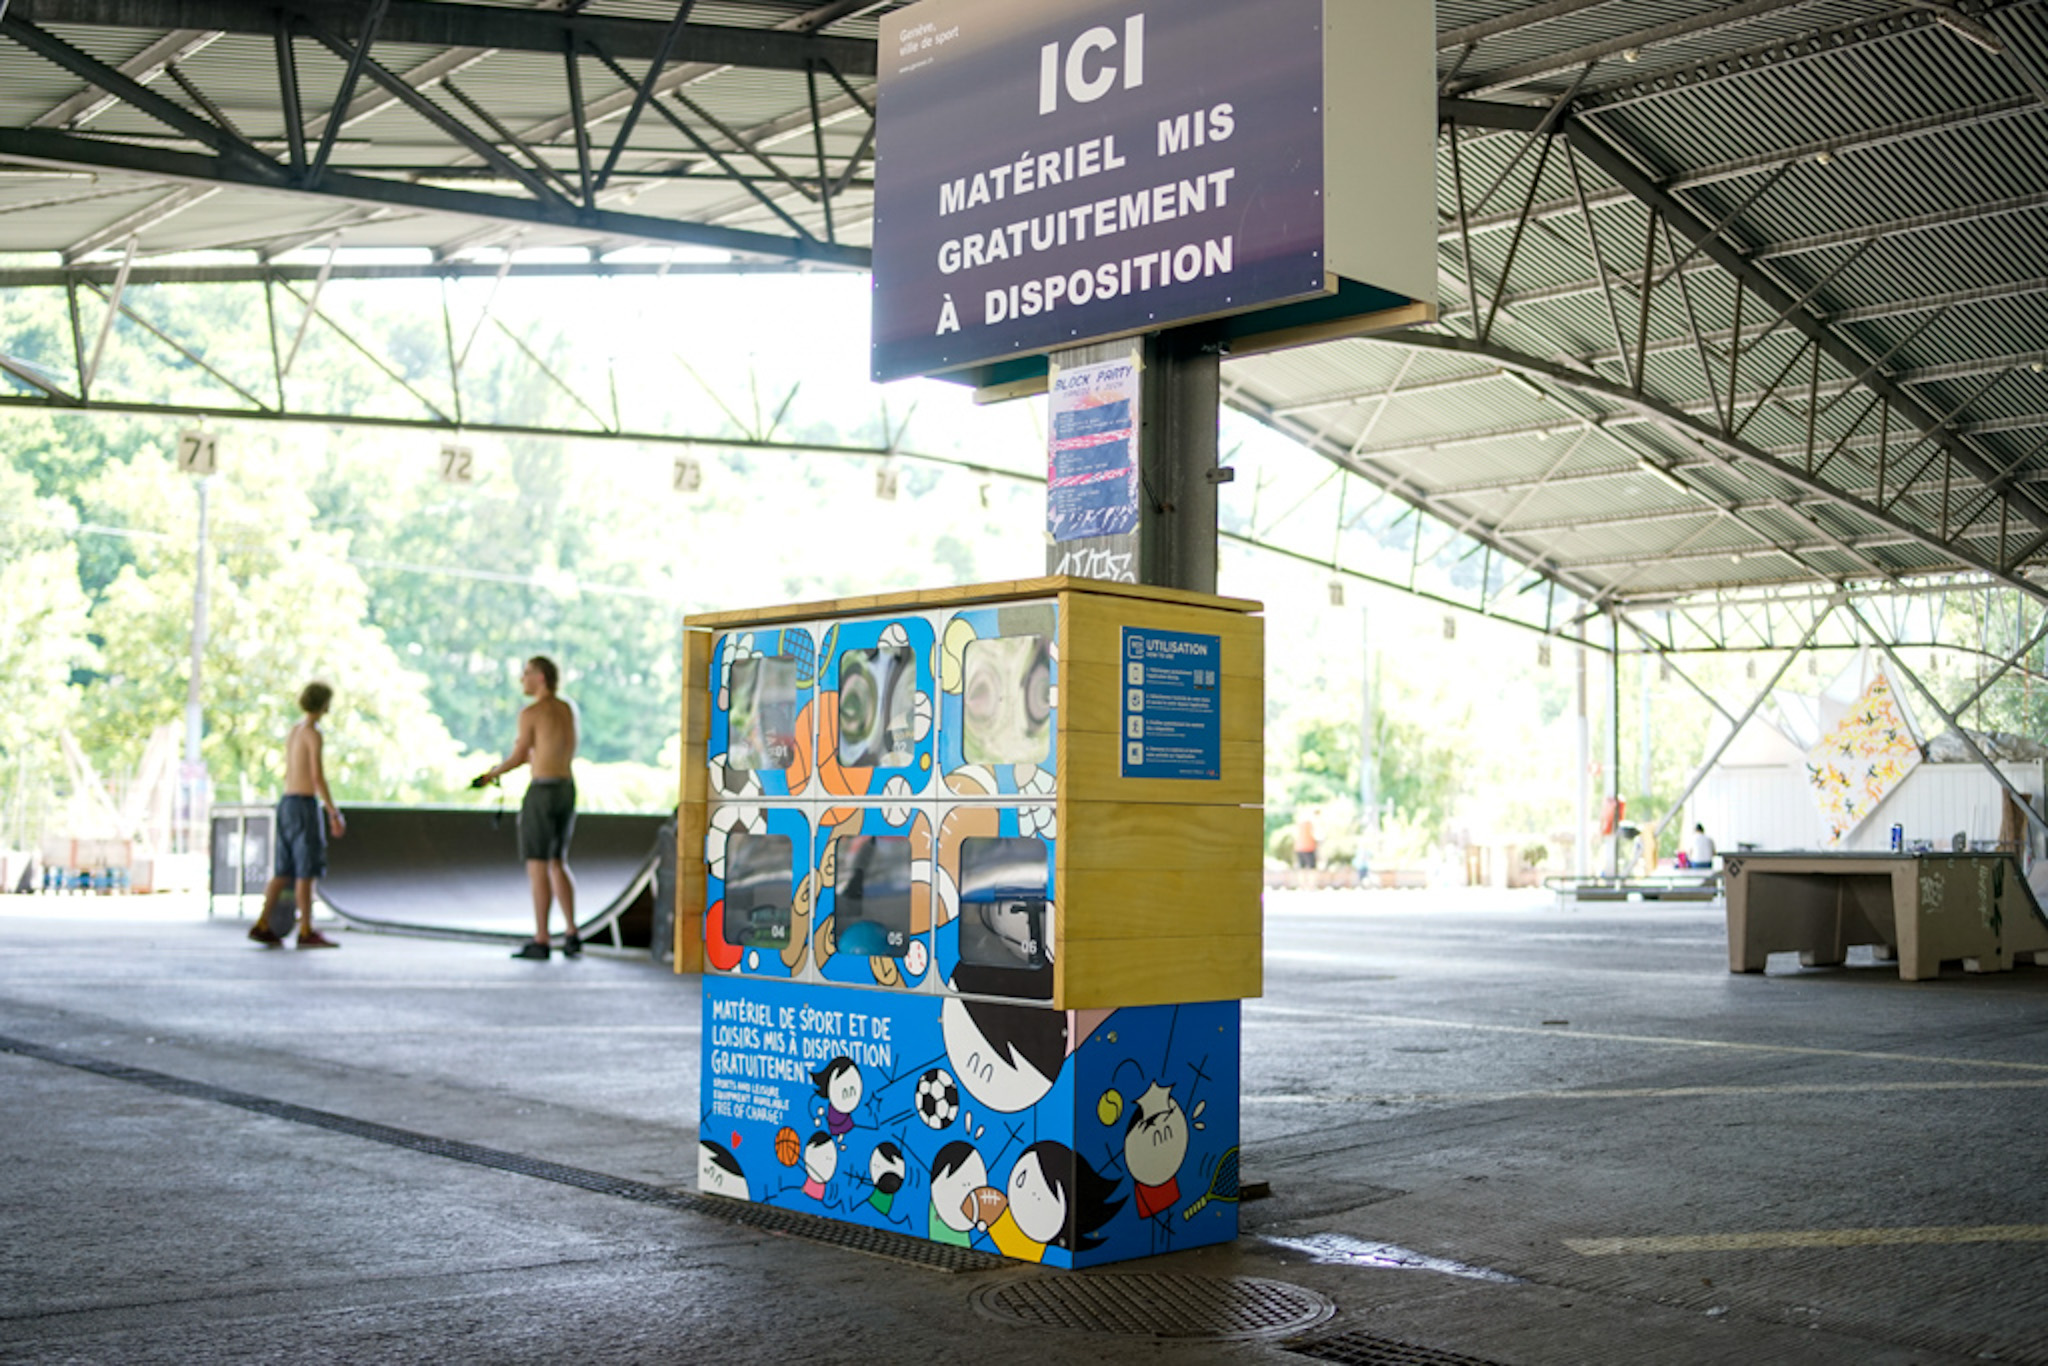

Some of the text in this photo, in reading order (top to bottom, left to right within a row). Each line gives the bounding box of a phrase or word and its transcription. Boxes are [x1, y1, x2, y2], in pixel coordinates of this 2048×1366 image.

[899, 25, 959, 56] ville de sport
[1039, 13, 1145, 115] ICI
[939, 103, 1235, 216] MATÉRIEL MIS
[938, 168, 1236, 275] GRATUITEMENT
[936, 235, 1233, 336] À DISPOSITION
[1054, 373, 1091, 391] BLOCK
[1096, 365, 1133, 383] PARTY
[184, 436, 216, 467] 71
[441, 450, 472, 480] 72
[1145, 639, 1208, 656] UTILISATION
[771, 925, 785, 938] 04
[887, 932, 903, 946] 05
[1020, 940, 1037, 954] 06
[712, 997, 892, 1041] MATÉRIEL DE SPORT ET DE
[712, 1025, 892, 1067] LOISIRS MIS À DISPOSITION
[711, 1049, 816, 1086] GRATUITEMENT
[713, 1101, 784, 1125] FREE OF CHARGE!
